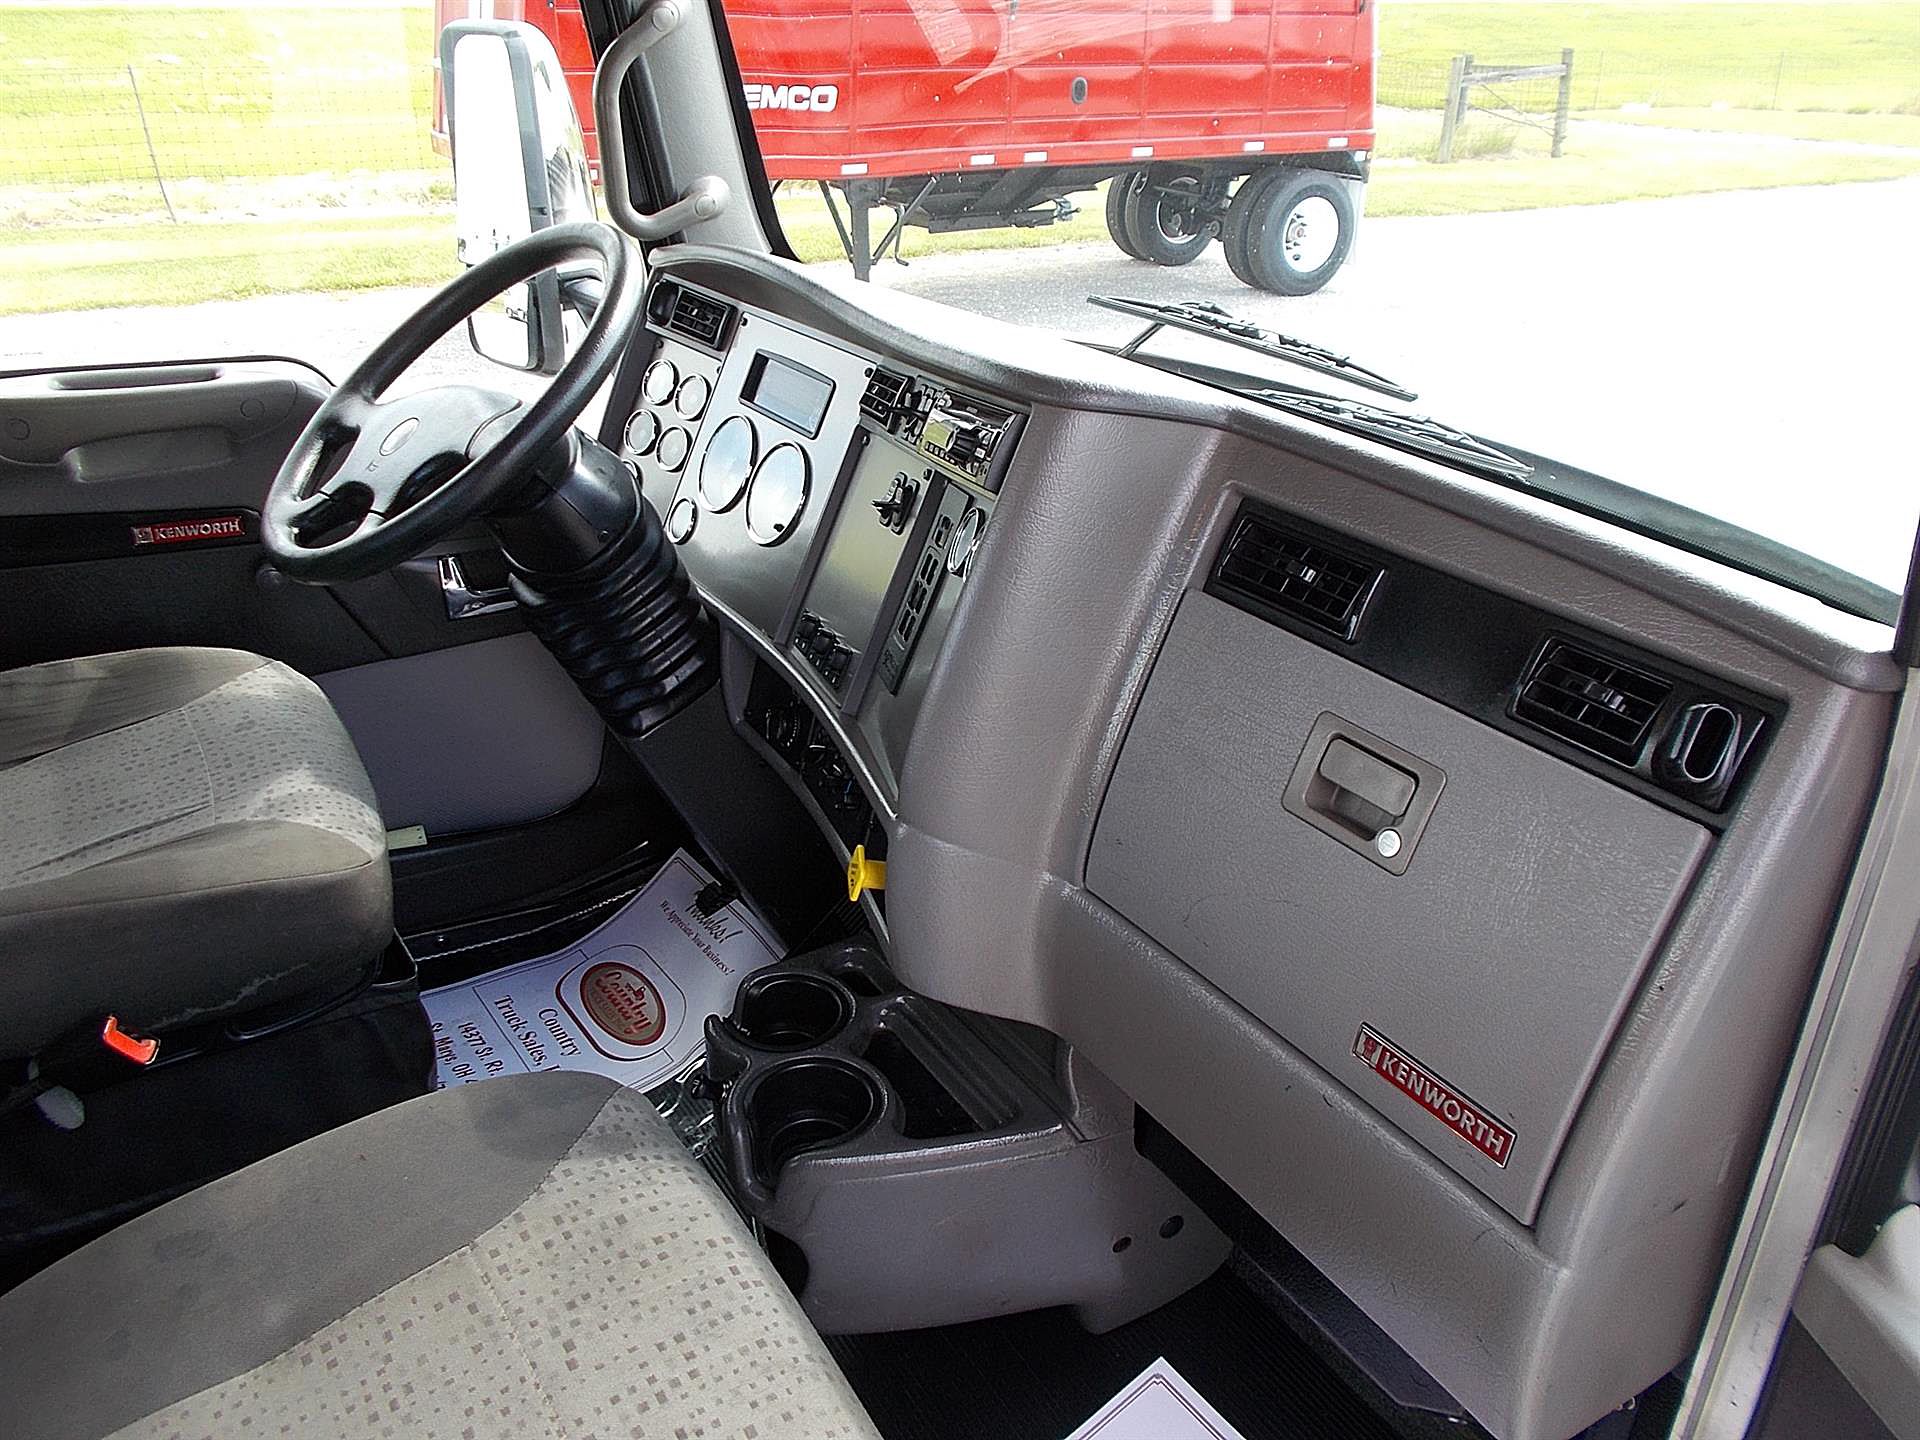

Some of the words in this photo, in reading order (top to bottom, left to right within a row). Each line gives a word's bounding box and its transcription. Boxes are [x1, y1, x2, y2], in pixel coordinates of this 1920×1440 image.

[155, 519, 240, 541] KENWORTH
[660, 900, 671, 912] We
[668, 910, 694, 937] Appreciate
[692, 933, 706, 948] Your
[702, 944, 735, 976] Business!
[599, 972, 652, 1034] Country
[432, 1022, 444, 1033] St
[458, 1022, 487, 1047] 14377
[494, 994, 528, 1033] Truck
[517, 1030, 547, 1066] Sales,
[538, 1008, 581, 1057] Country
[435, 1036, 458, 1065] Marys,
[475, 1046, 494, 1061] St.
[452, 1063, 476, 1079] OH
[484, 1060, 504, 1077] Rt.
[1382, 1052, 1504, 1156] KENWORTH
